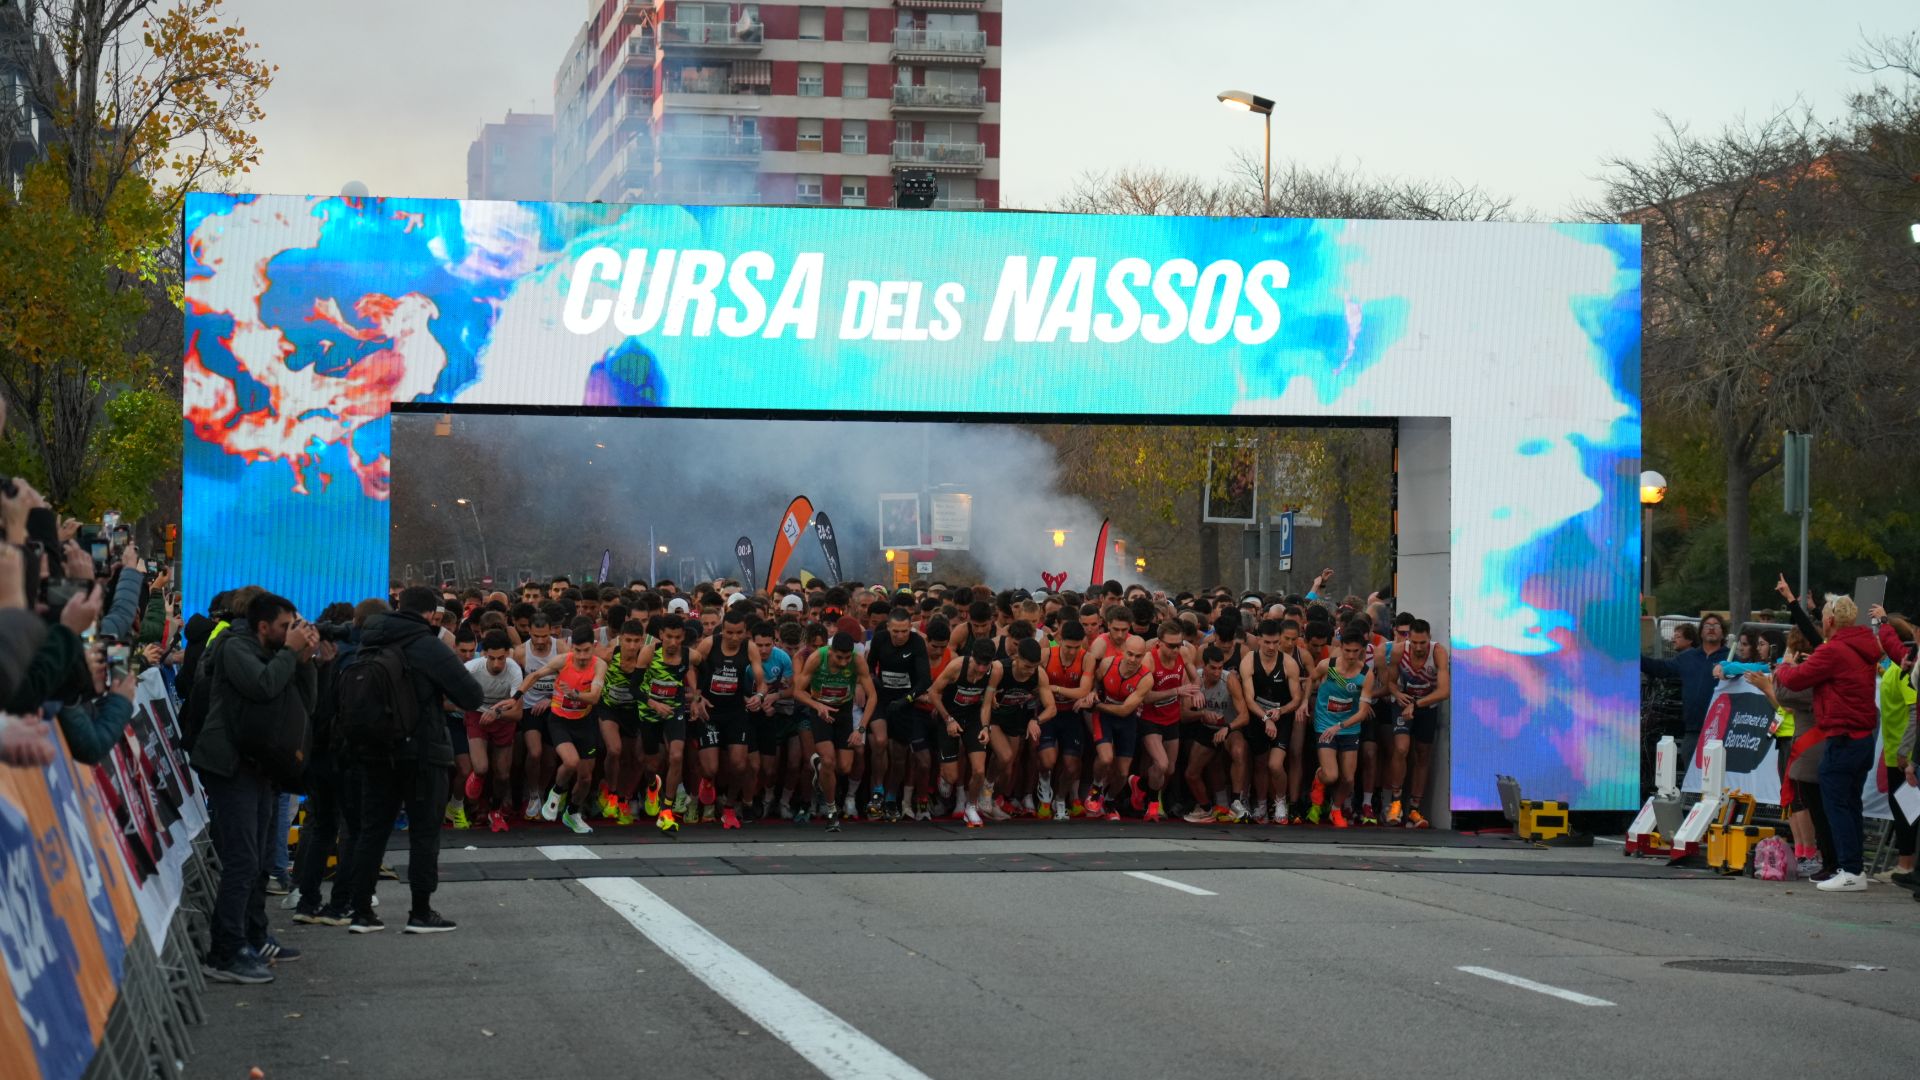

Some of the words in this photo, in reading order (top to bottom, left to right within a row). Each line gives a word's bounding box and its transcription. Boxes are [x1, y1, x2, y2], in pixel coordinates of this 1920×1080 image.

[562, 247, 825, 339] CURSA
[839, 280, 965, 342] DELS
[983, 255, 1290, 344] NASSOS
[1281, 517, 1290, 552] P
[1759, 714, 1769, 728] de
